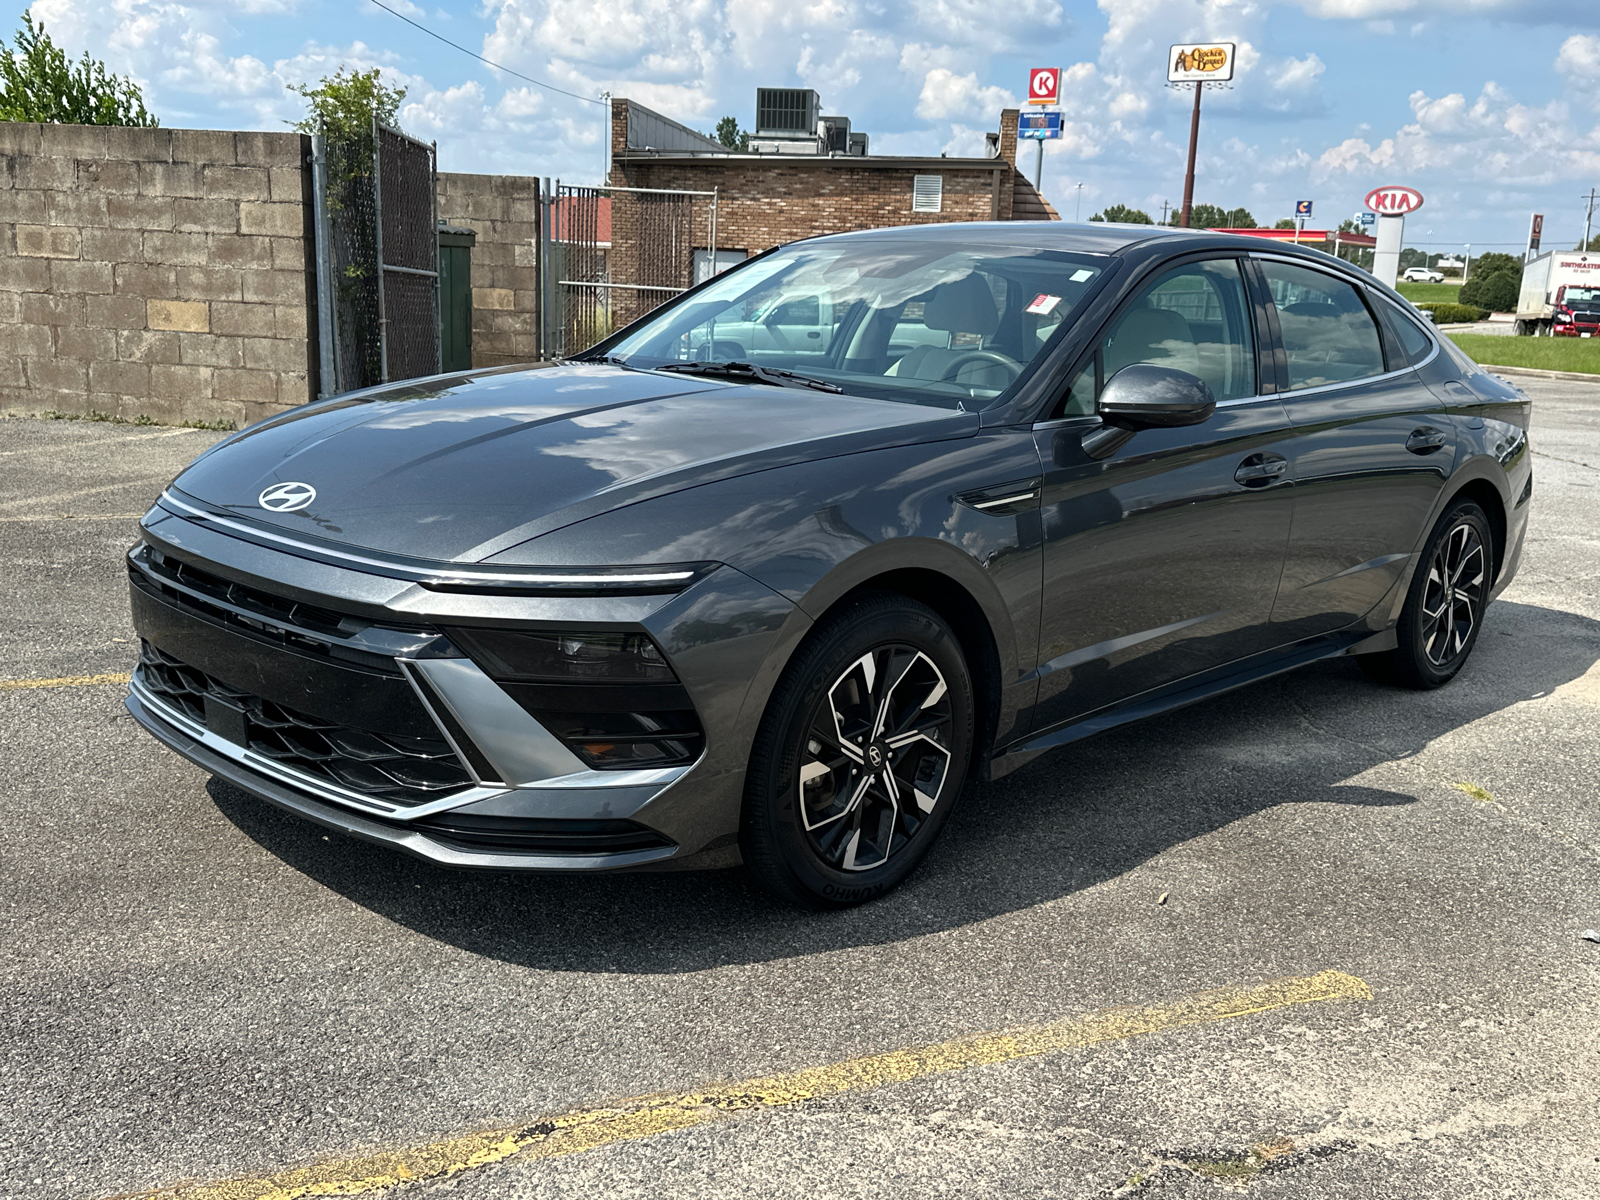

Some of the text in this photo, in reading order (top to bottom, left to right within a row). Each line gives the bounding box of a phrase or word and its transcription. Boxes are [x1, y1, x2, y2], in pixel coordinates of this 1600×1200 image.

[1197, 57, 1224, 70] Barrel
[1039, 76, 1052, 93] K
[1375, 193, 1411, 210] KIA
[822, 883, 884, 900] KUMHO
